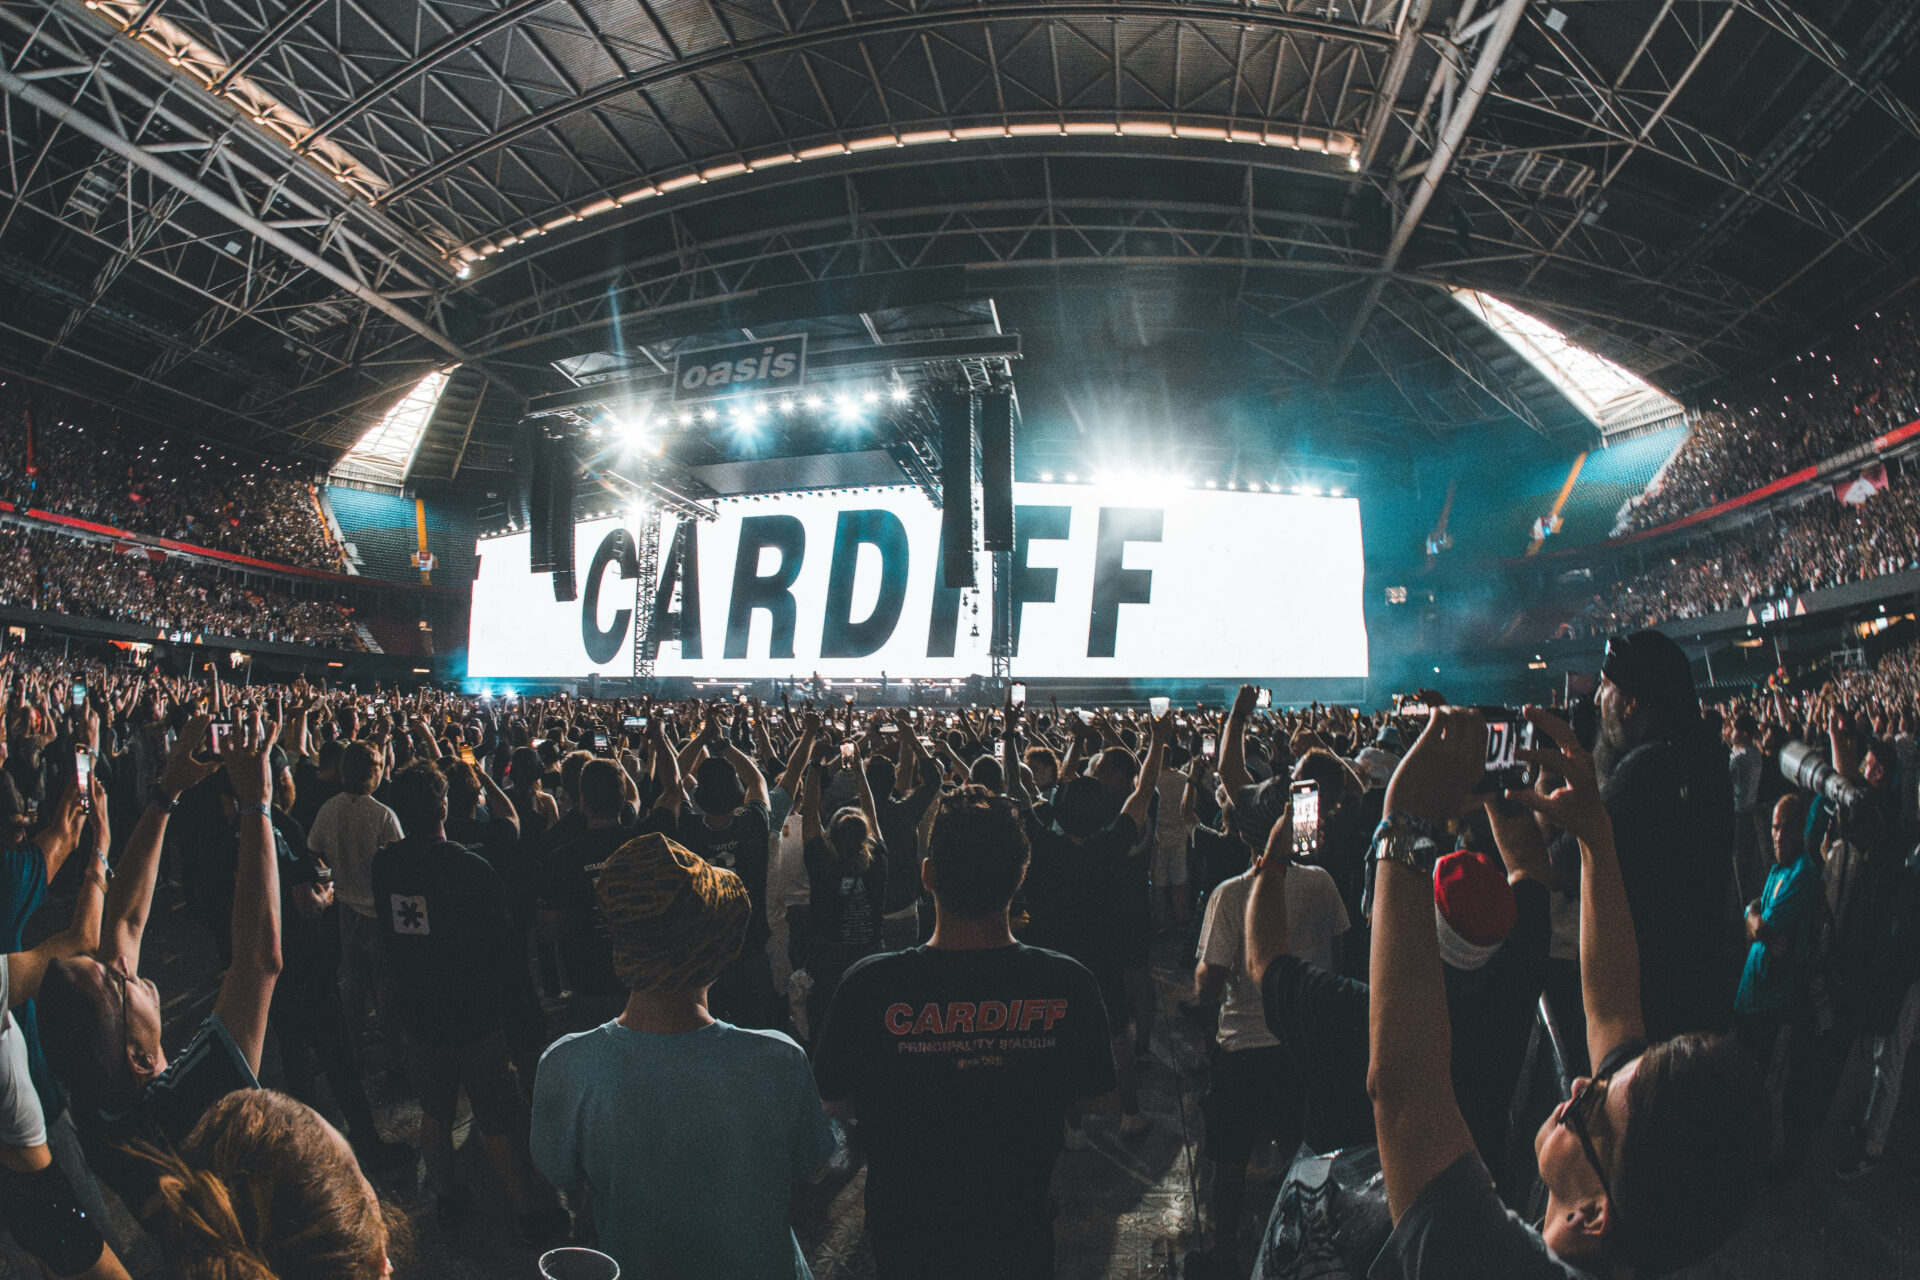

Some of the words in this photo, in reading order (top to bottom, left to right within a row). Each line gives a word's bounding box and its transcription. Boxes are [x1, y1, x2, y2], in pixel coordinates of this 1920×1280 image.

[681, 346, 798, 390] oasis
[581, 504, 1165, 665] CARDIFF
[884, 999, 1068, 1036] CARDIFF
